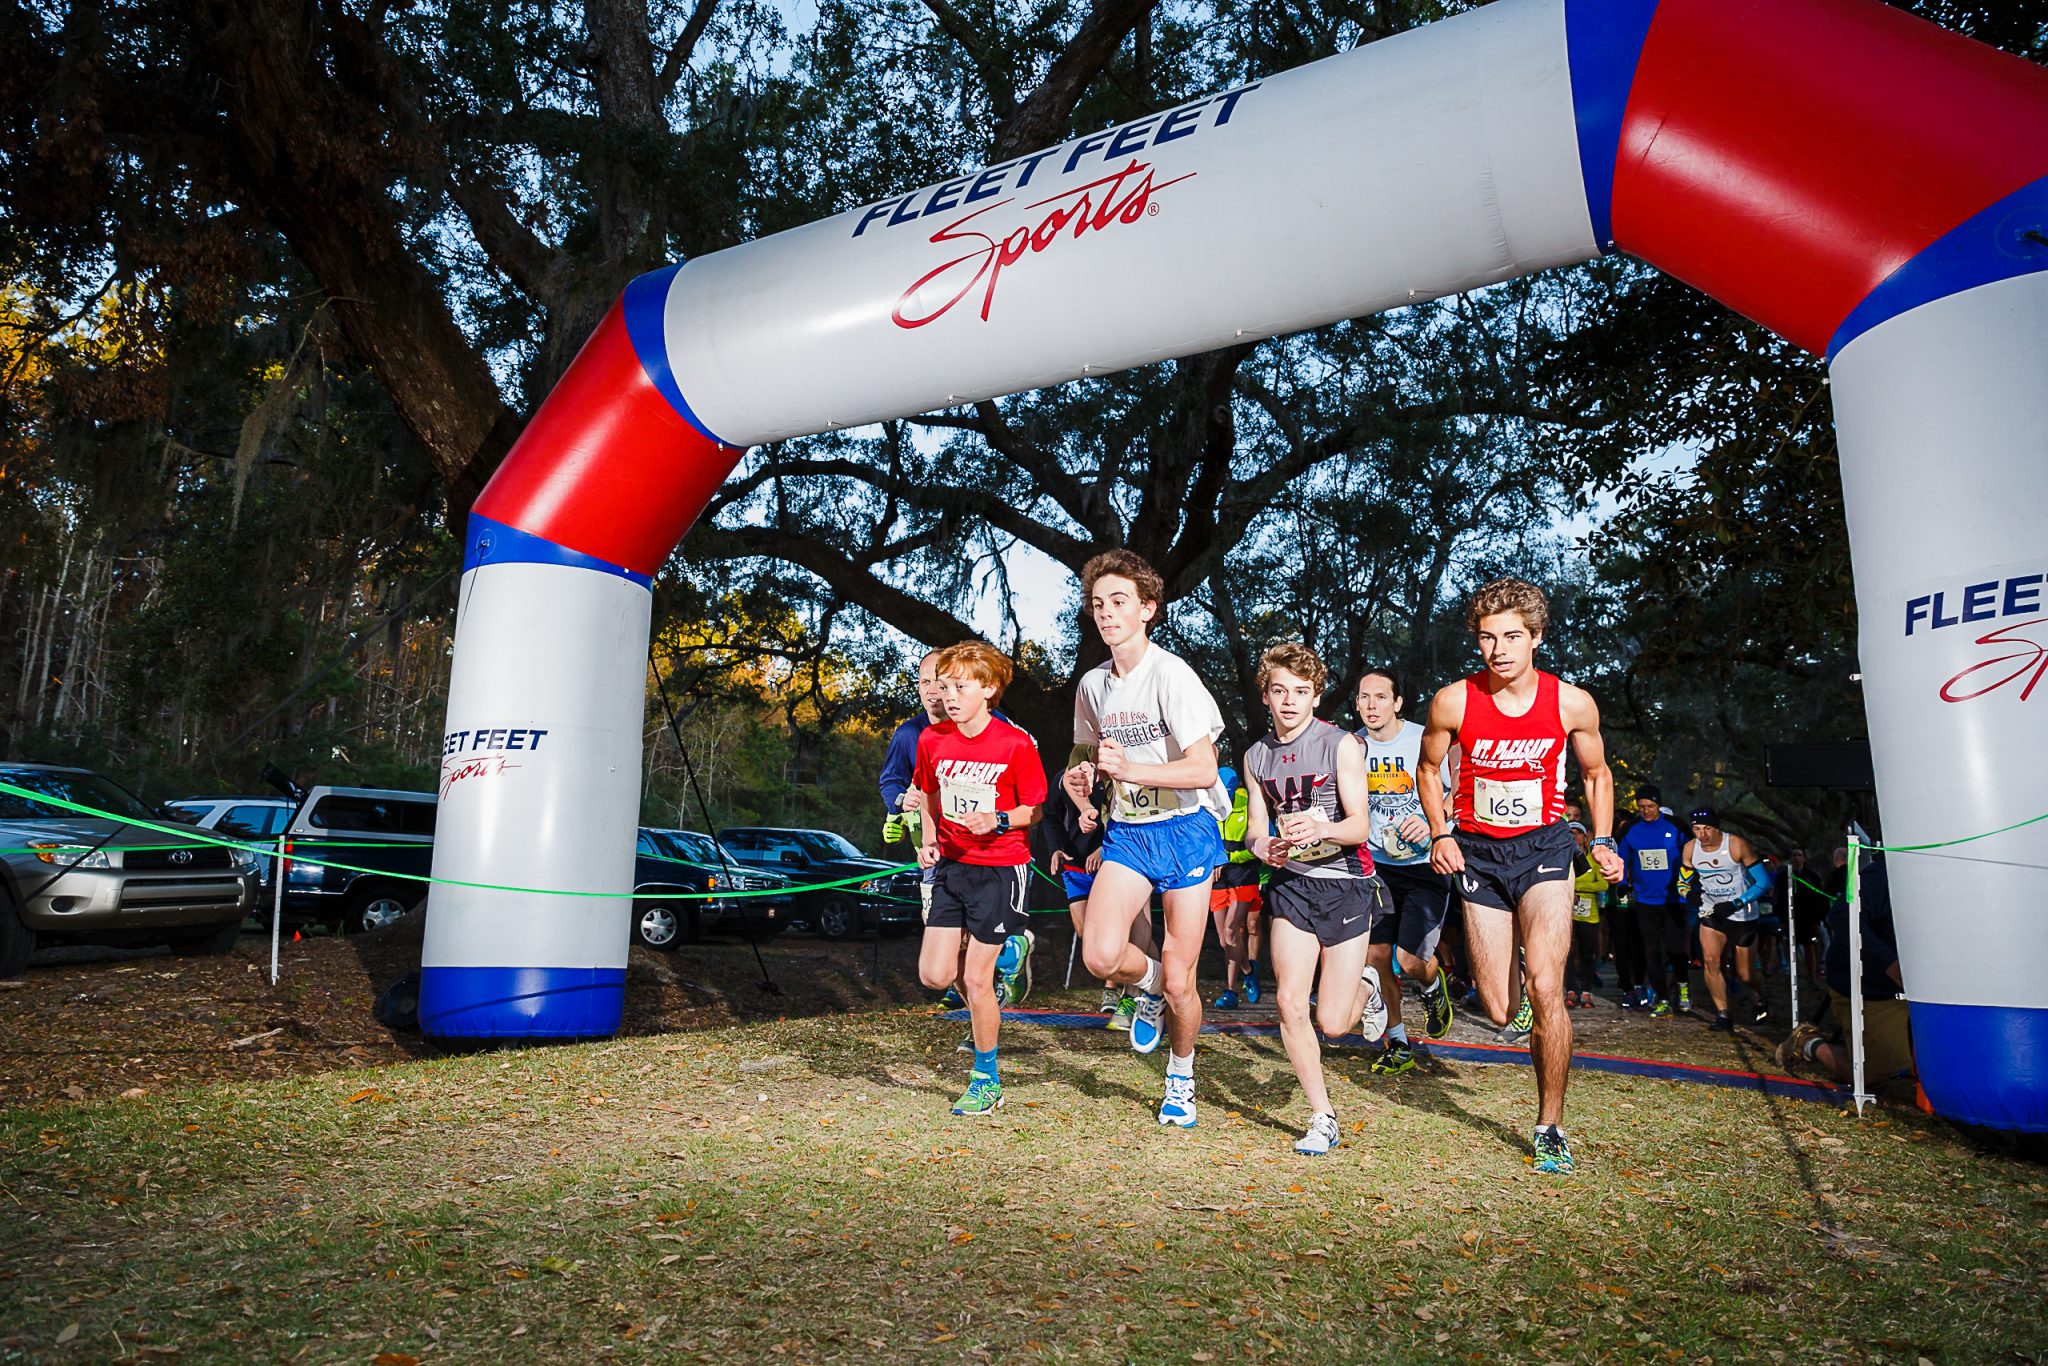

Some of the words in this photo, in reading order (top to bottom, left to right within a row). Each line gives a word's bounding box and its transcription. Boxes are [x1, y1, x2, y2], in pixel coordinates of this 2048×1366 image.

[852, 149, 1060, 238] FLEET
[1062, 83, 1263, 174] FEET
[891, 158, 1198, 330] Sports
[1905, 573, 2048, 636] FLEE
[1120, 711, 1149, 727] BLESS
[472, 729, 549, 751] FEET
[1491, 738, 1556, 760] PLEASANT
[951, 760, 1008, 784] PLEASANT
[953, 794, 979, 814] 137
[1490, 797, 1527, 817] 165
[1646, 856, 1660, 866] 56
